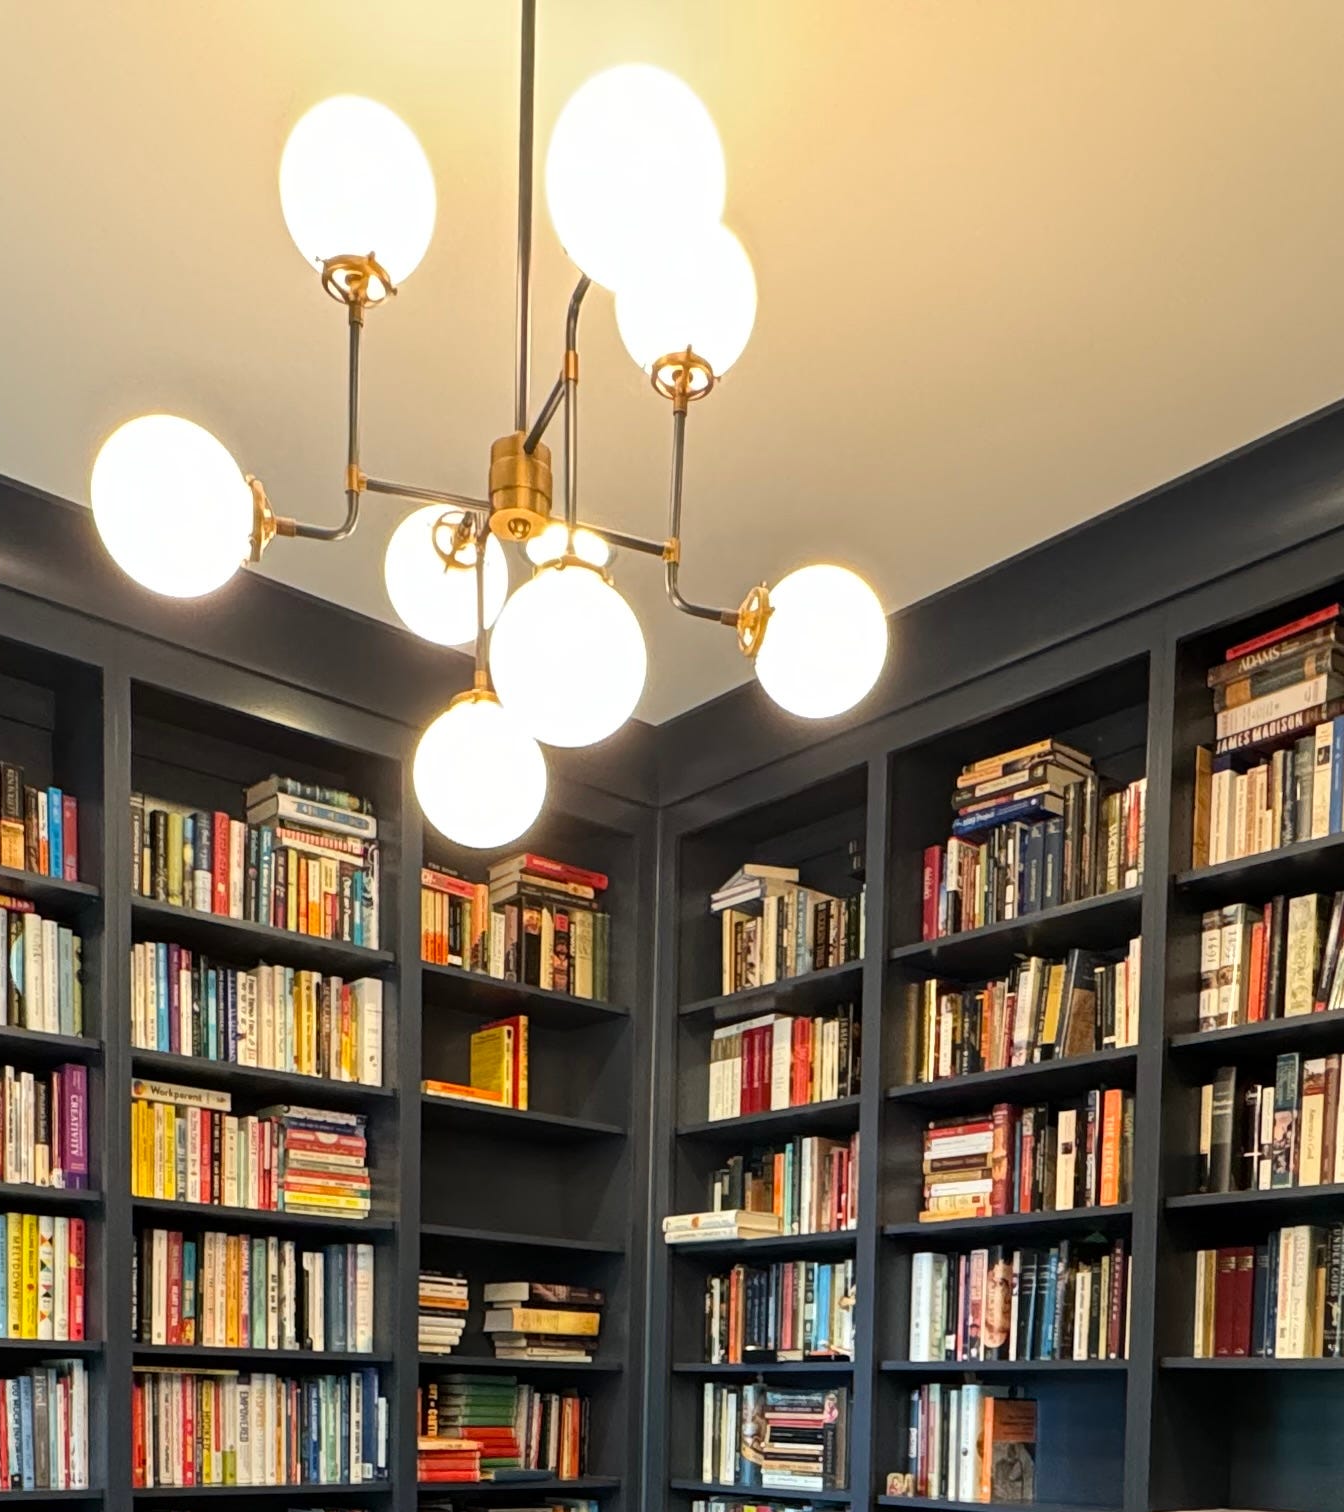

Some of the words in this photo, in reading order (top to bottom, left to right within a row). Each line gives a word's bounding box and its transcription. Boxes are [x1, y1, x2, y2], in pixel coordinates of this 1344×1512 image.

[1236, 645, 1284, 674] ADAMS
[1215, 732, 1251, 755] JAMES
[1253, 711, 1304, 743] MADISON
[149, 1084, 204, 1103] Workparent
[69, 1093, 82, 1158] CREATIVITY
[1105, 1115, 1116, 1139] THE
[1105, 1141, 1116, 1179] VERGE
[1330, 1228, 1342, 1264] UNDER
[11, 1235, 22, 1300] MELTDOWN
[239, 1390, 250, 1442] EMPOWERED
